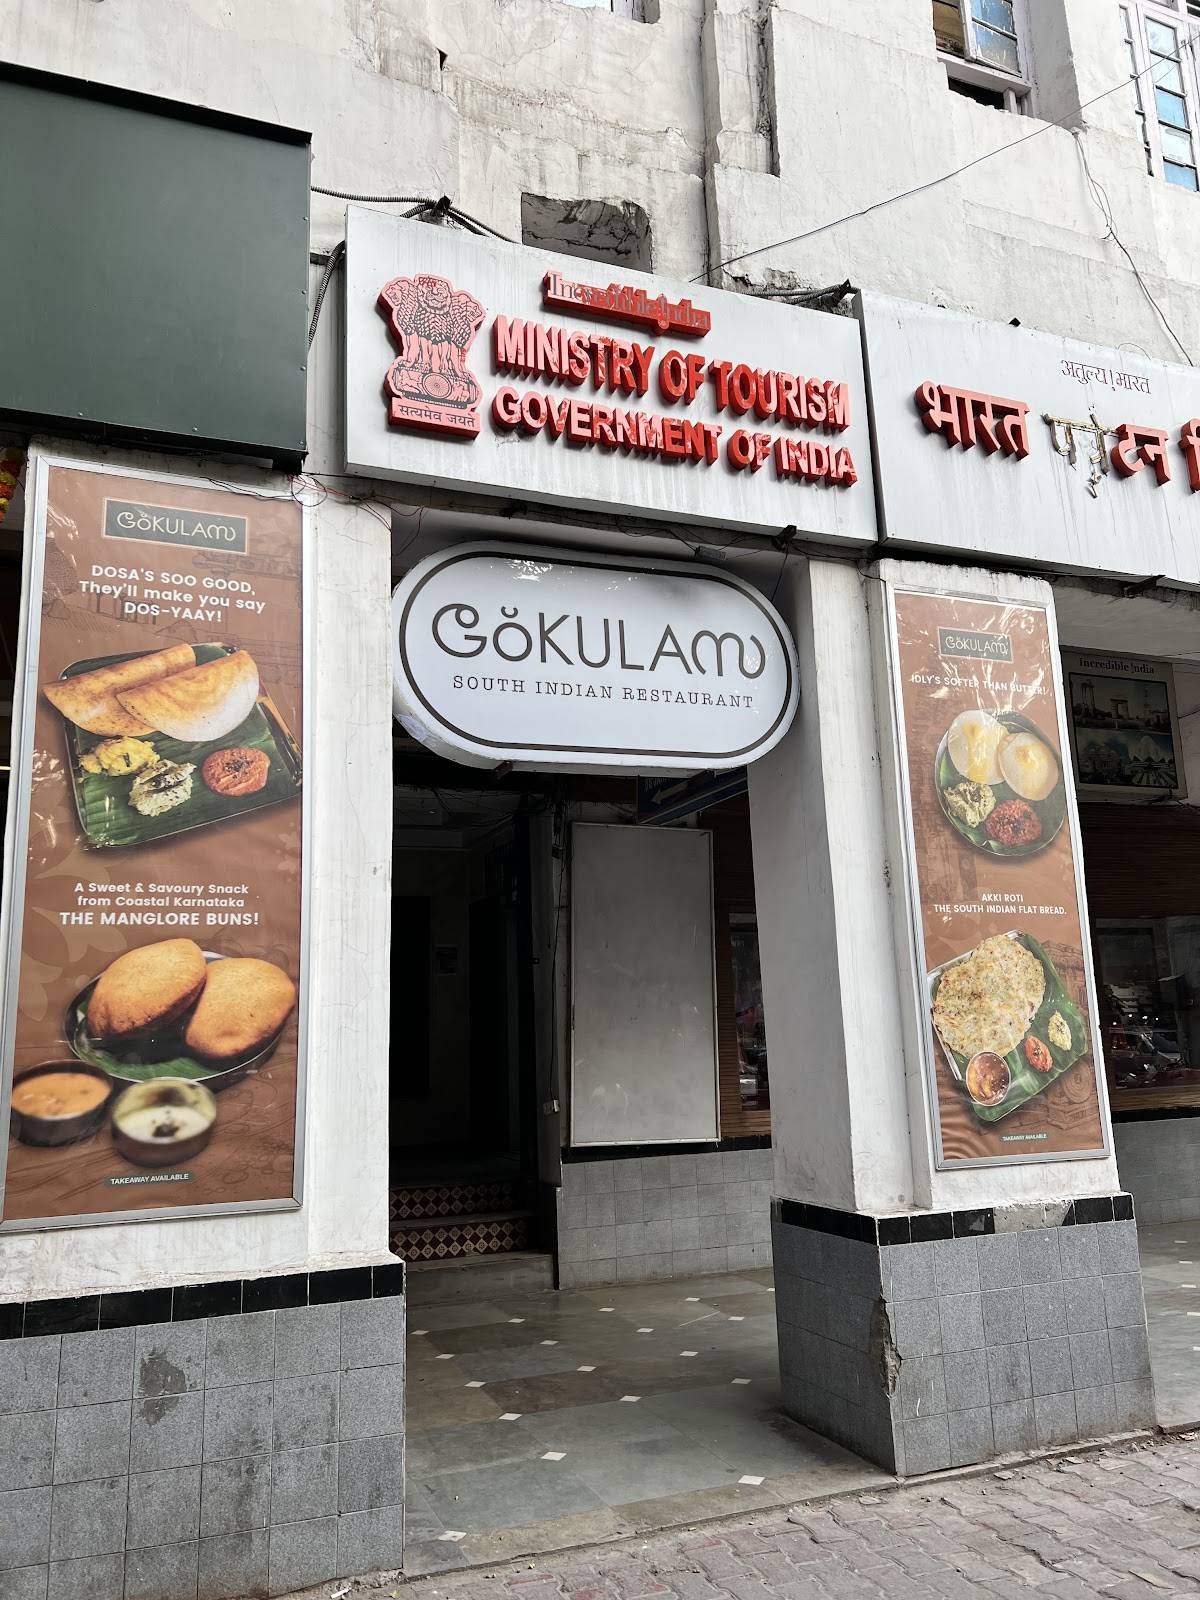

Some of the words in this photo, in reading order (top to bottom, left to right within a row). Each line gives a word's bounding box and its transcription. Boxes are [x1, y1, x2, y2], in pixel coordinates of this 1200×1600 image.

[493, 313, 656, 397] MINISTRY
[658, 349, 706, 404] OF
[708, 357, 851, 433] TOURISM
[398, 404, 442, 422] सत्यमेव
[446, 412, 475, 427] जयते
[915, 381, 1030, 461] भारत
[492, 385, 722, 466] GOVERNMENT
[726, 428, 771, 473] OF
[774, 435, 858, 487] INDIA
[91, 564, 155, 582] DOSA'S
[160, 572, 197, 586] SOO
[202, 576, 256, 596] GOOD,
[79, 580, 138, 598] They'll
[144, 587, 193, 603] make
[198, 594, 230, 607] you
[236, 600, 265, 614] say
[124, 601, 222, 622] DOS-YAAY!
[453, 675, 526, 693] SOUTH
[535, 681, 613, 699] INDIAN
[621, 687, 753, 708] RESTAURANT
[911, 674, 941, 685] IDLY'S
[944, 677, 980, 689] SOFTER
[982, 680, 1008, 691] THAN
[1010, 682, 1046, 696] BUTR!
[74, 883, 84, 892] A
[88, 883, 130, 893] Sweet
[134, 883, 144, 893] &
[148, 884, 203, 896] Savoury
[208, 884, 249, 894] Snack
[981, 894, 1002, 902] AKKI
[1004, 894, 1024, 903] ROTI
[77, 896, 111, 906] from
[115, 897, 169, 907] Coastal
[174, 897, 245, 908] Karnataka
[933, 904, 951, 913] THE
[953, 904, 984, 913] SOUTH
[986, 905, 1017, 914] INDIAN
[1018, 906, 1037, 914] FLAT
[1039, 906, 1067, 915] BREAD.
[60, 912, 94, 925] THE
[100, 912, 200, 926] MANGLORE
[206, 913, 260, 926] BUNS!
[111, 1176, 150, 1185] TAKEAWAY
[150, 1173, 189, 1182] AVAILABLE
